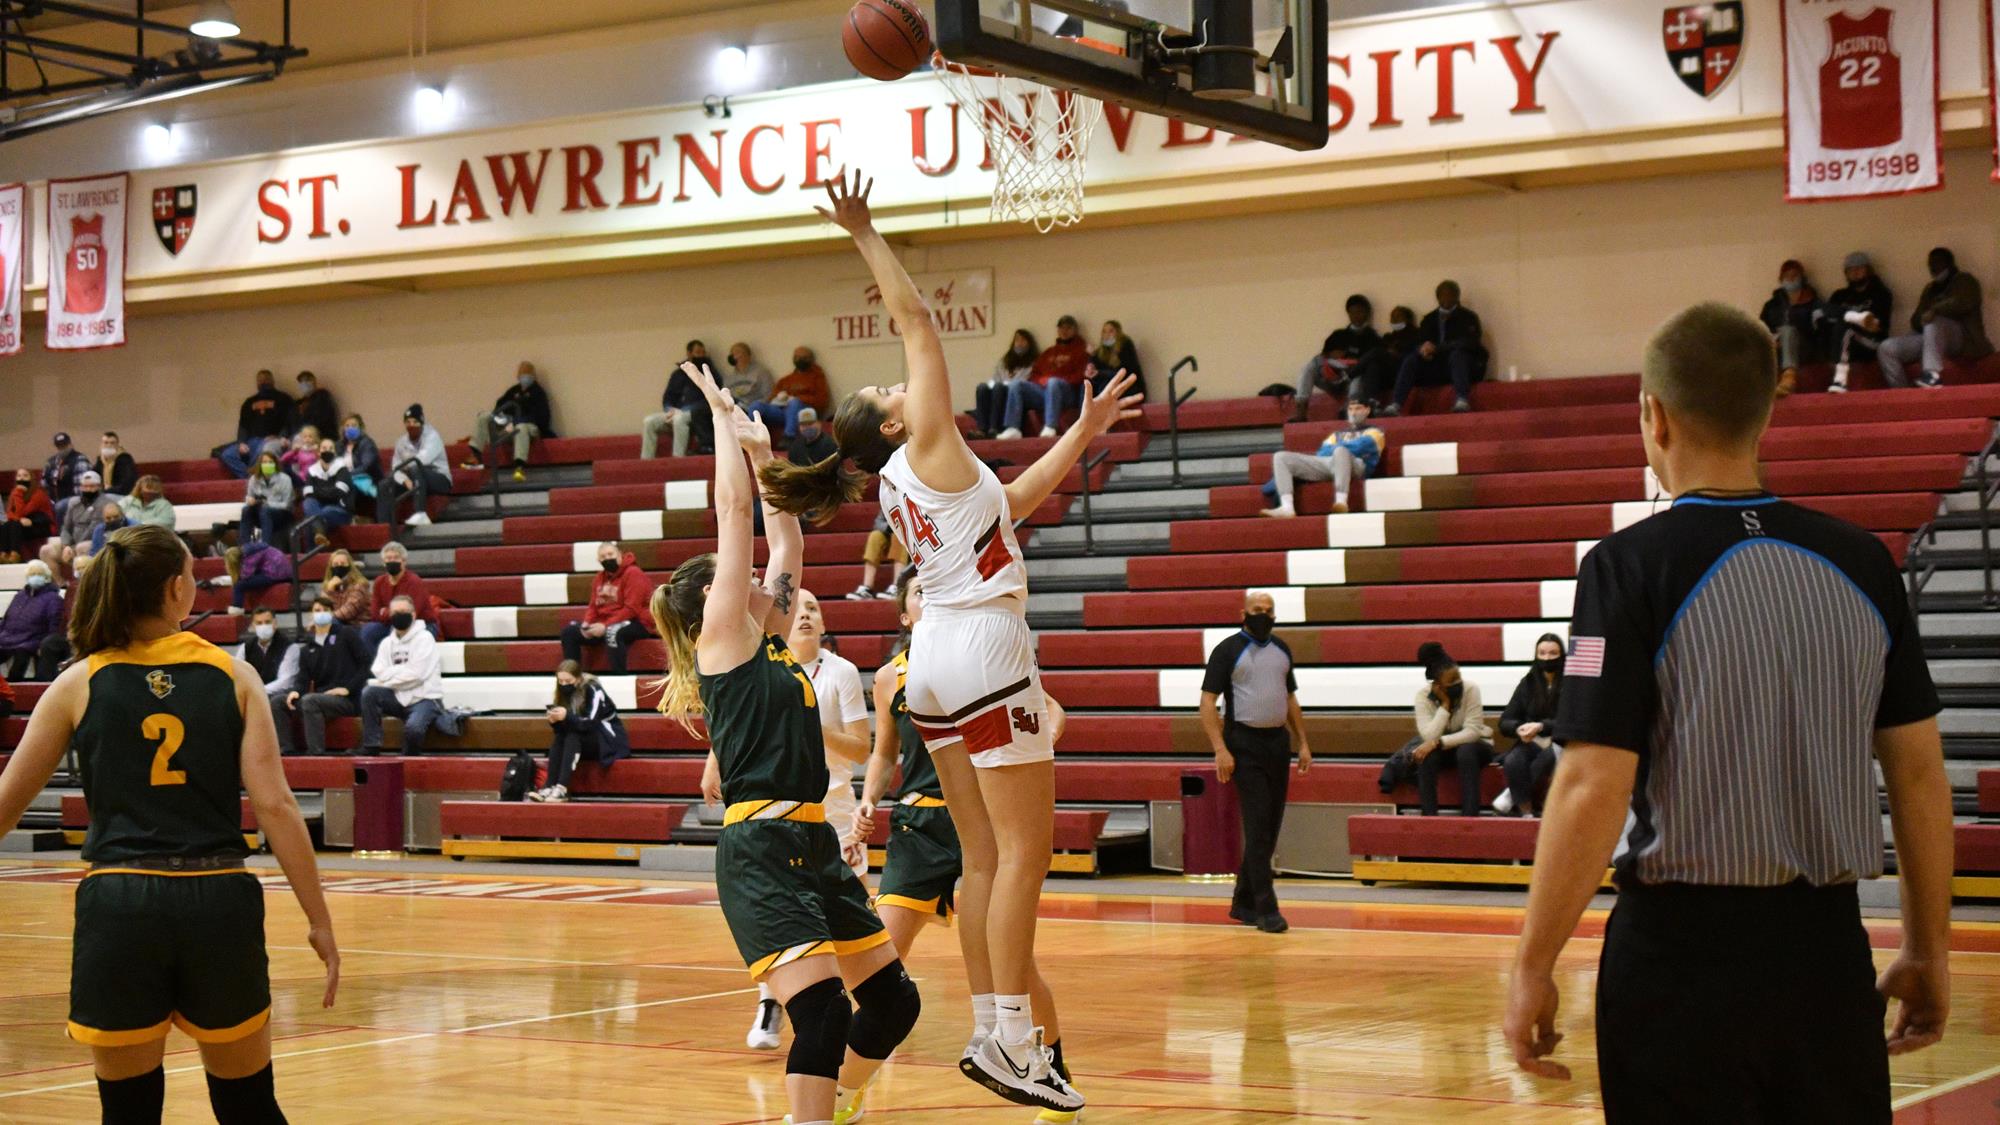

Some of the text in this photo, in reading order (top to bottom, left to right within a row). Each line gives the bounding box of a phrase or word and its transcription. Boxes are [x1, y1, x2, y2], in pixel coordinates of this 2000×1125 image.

[1839, 57, 1881, 89] 22
[257, 31, 1561, 245] ST. LAWRENCE UNIVSITY
[77, 248, 98, 270] 50
[934, 279, 955, 306] of
[833, 313, 881, 341] THE
[888, 492, 944, 569] 24
[141, 712, 187, 787] 2
